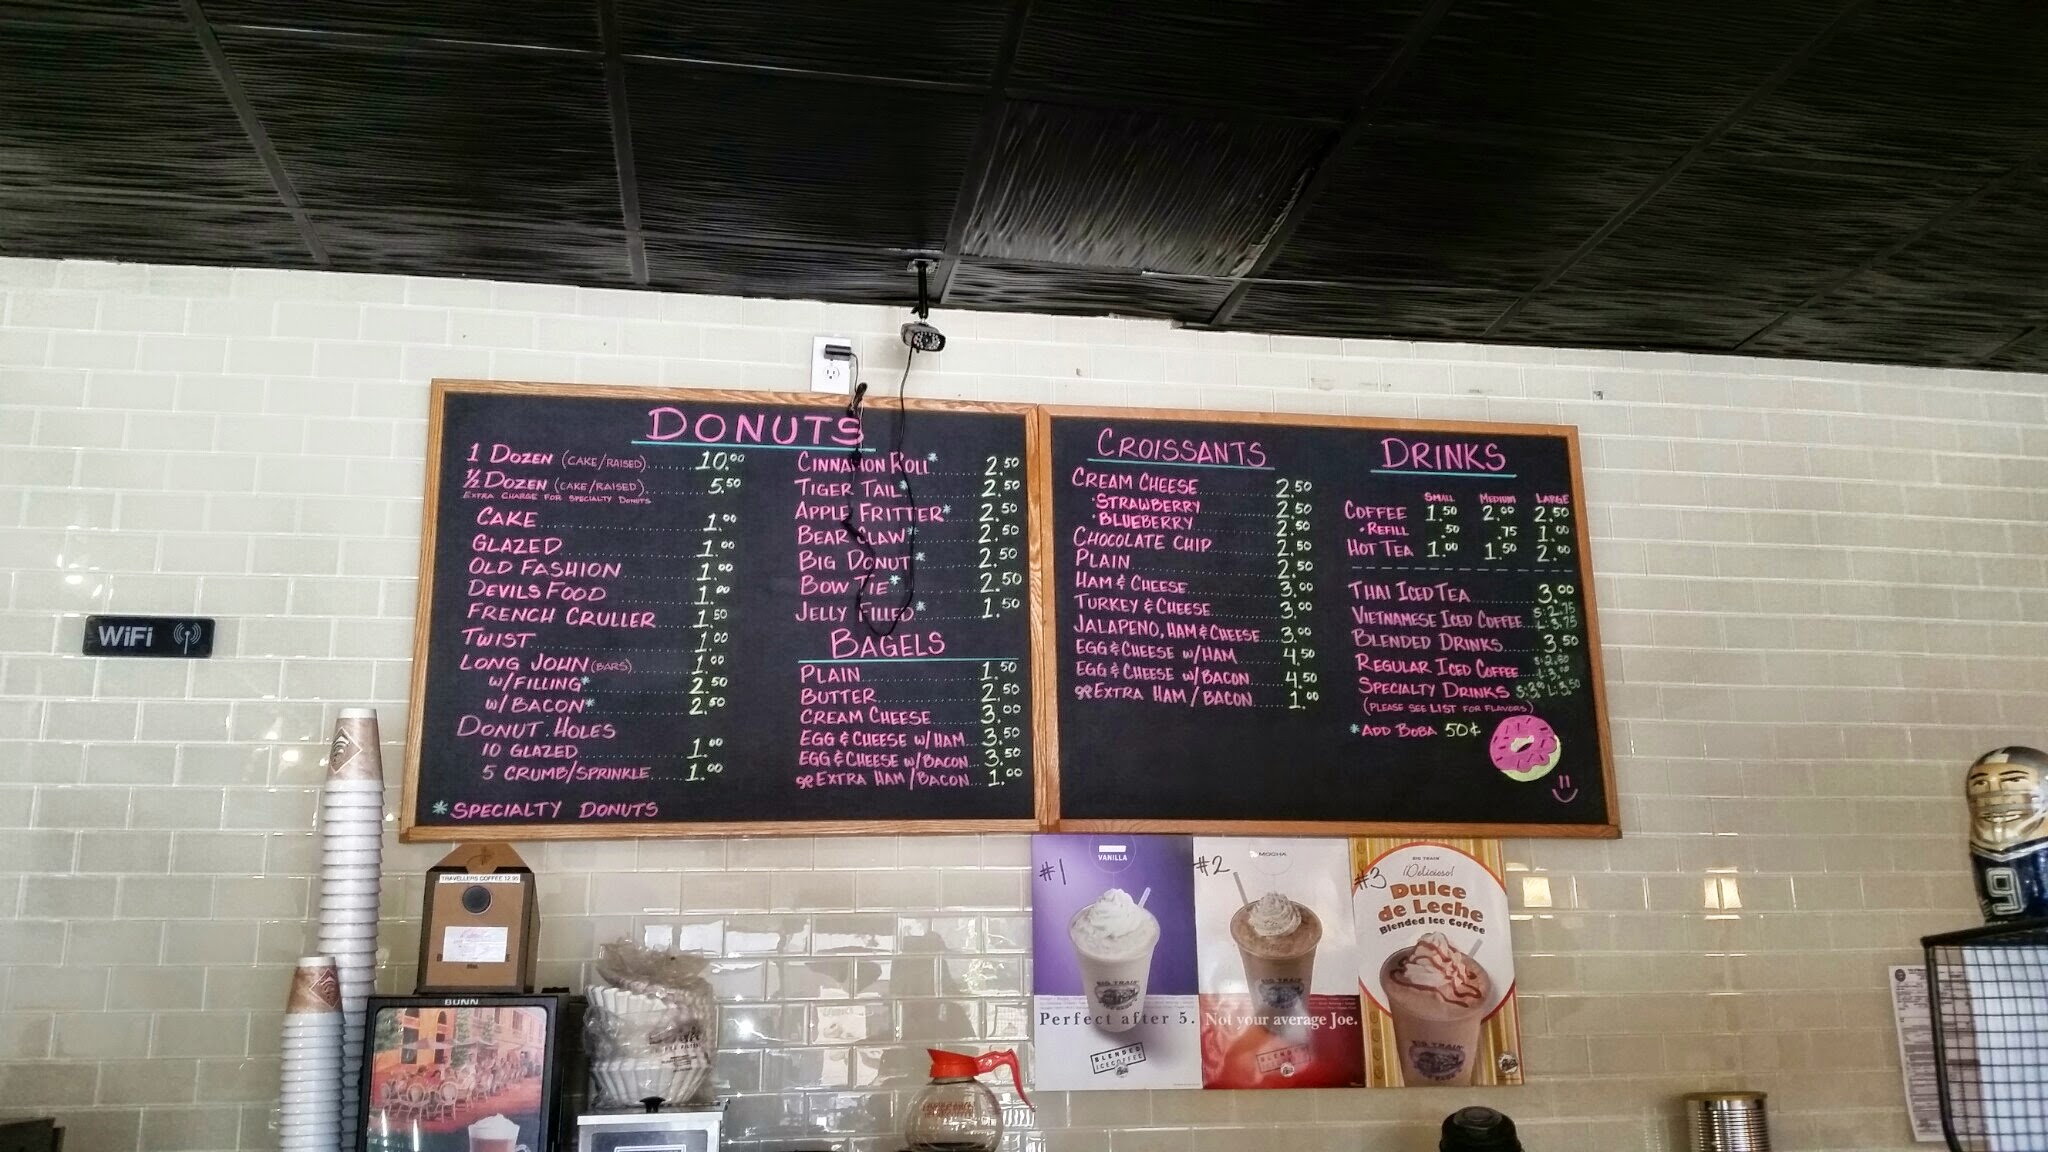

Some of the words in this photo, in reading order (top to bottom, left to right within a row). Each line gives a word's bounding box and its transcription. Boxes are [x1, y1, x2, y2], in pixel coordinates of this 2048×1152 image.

[646, 405, 864, 446] DONUTS
[467, 443, 480, 462] 1
[489, 443, 553, 464] DOZEN
[1097, 427, 1267, 467] CROISSANTS
[1381, 438, 1506, 471] DRINKS
[890, 451, 928, 475] ROLL
[484, 471, 548, 490] DOZEN
[794, 477, 853, 497] TIGER
[861, 479, 902, 498] TAIL
[1072, 467, 1132, 489] CREAM
[1139, 472, 1199, 495] CHEESE
[501, 492, 537, 500] CHARGE
[569, 494, 612, 503] SPECIALTY
[1095, 493, 1200, 514] STRAWBERRY
[1424, 493, 1455, 502] SMALL
[1479, 493, 1516, 504] MEDIUM
[1536, 493, 1570, 504] LARGE
[476, 506, 539, 528] CAKE
[860, 503, 944, 522] FRITTER
[1345, 501, 1407, 520] COFFEE
[1099, 512, 1194, 531] BLUEBERRY
[1368, 522, 1409, 536] REFILL
[473, 534, 563, 555] GLAZED
[797, 525, 849, 545] BEAR
[1073, 526, 1165, 550] CHOCOLATE
[1173, 536, 1212, 552] CHIP
[1347, 539, 1377, 556] HOT
[1379, 539, 1414, 557] TEA
[468, 558, 513, 578] OLD
[520, 559, 621, 579] FASHION
[799, 549, 836, 571] BIG
[847, 549, 910, 571] DONUT
[1075, 548, 1130, 569] PLAIN
[468, 579, 542, 600] DEVILS
[546, 581, 606, 600] FOOD
[800, 574, 849, 595] BOW
[1076, 571, 1111, 589] HAM
[1131, 574, 1188, 594] CHEESE
[1348, 581, 1391, 601] THAI
[1397, 581, 1433, 601] ICED
[1435, 583, 1470, 602] TEA
[796, 600, 847, 622] JELLY
[1074, 593, 1138, 614] TURKEY
[1156, 598, 1211, 616] CHEESE
[467, 603, 556, 623] FRENCH
[566, 606, 656, 628] CRULLER
[1352, 606, 1437, 627] VIETNAMESE
[1440, 610, 1472, 628] ICED
[1478, 610, 1522, 629] COFFEE
[98, 626, 153, 647] WiFi
[461, 627, 536, 648] TWIST
[831, 628, 946, 659] BAGELS
[1210, 625, 1261, 643] CHEESE
[1352, 628, 1431, 648] BLENDED
[1438, 633, 1503, 652] DRINKS
[1076, 639, 1108, 655] EGG
[1122, 641, 1174, 659] CHEESE
[459, 654, 520, 672] LONG
[531, 653, 590, 673] JOHN
[590, 659, 633, 673] (BARS)
[1076, 661, 1108, 678] EGG
[1122, 663, 1174, 681] CHEESE
[1355, 653, 1432, 674] REGULAR
[1435, 658, 1471, 676] ICED
[1476, 659, 1519, 678] COFFEE
[801, 664, 861, 684] PLAIN
[800, 688, 877, 705] BUTTER
[1094, 683, 1143, 700] EXTRA
[1358, 676, 1435, 695] SPECIALTY
[1442, 682, 1510, 698] DRINKS
[800, 709, 863, 725] CREAM
[869, 706, 931, 725] CHEESE
[1408, 704, 1427, 712] SEE
[1430, 704, 1457, 713] LIST
[456, 715, 543, 737] DONUT
[554, 716, 616, 739] HOLES
[1362, 724, 1391, 736] ADD
[1395, 724, 1437, 738] BOBA
[800, 729, 835, 746] EGG
[852, 731, 907, 747] CHEESE
[482, 743, 501, 758] 10
[510, 744, 578, 758] GLAZED
[799, 750, 831, 767] EGG
[846, 751, 898, 768] CHEESE
[482, 765, 498, 780] 5
[816, 772, 867, 787] EXTRA
[450, 800, 562, 819] SPECIALTY
[579, 802, 658, 819] DONUTS
[1390, 881, 1466, 899] Dulce
[1378, 905, 1407, 922] de
[1413, 900, 1484, 923] Leche
[1379, 917, 1426, 935] Blended
[1428, 917, 1445, 925] Ice
[1449, 918, 1486, 935] Coffee
[445, 998, 479, 1006] BUNN
[1040, 1012, 1112, 1025] Perfect
[1121, 1012, 1169, 1025] after
[1179, 1012, 1195, 1024] 5.
[1205, 1012, 1232, 1026] Not
[1237, 1016, 1269, 1030] your
[1274, 1016, 1327, 1029] average
[1330, 1012, 1358, 1030] Joe.
